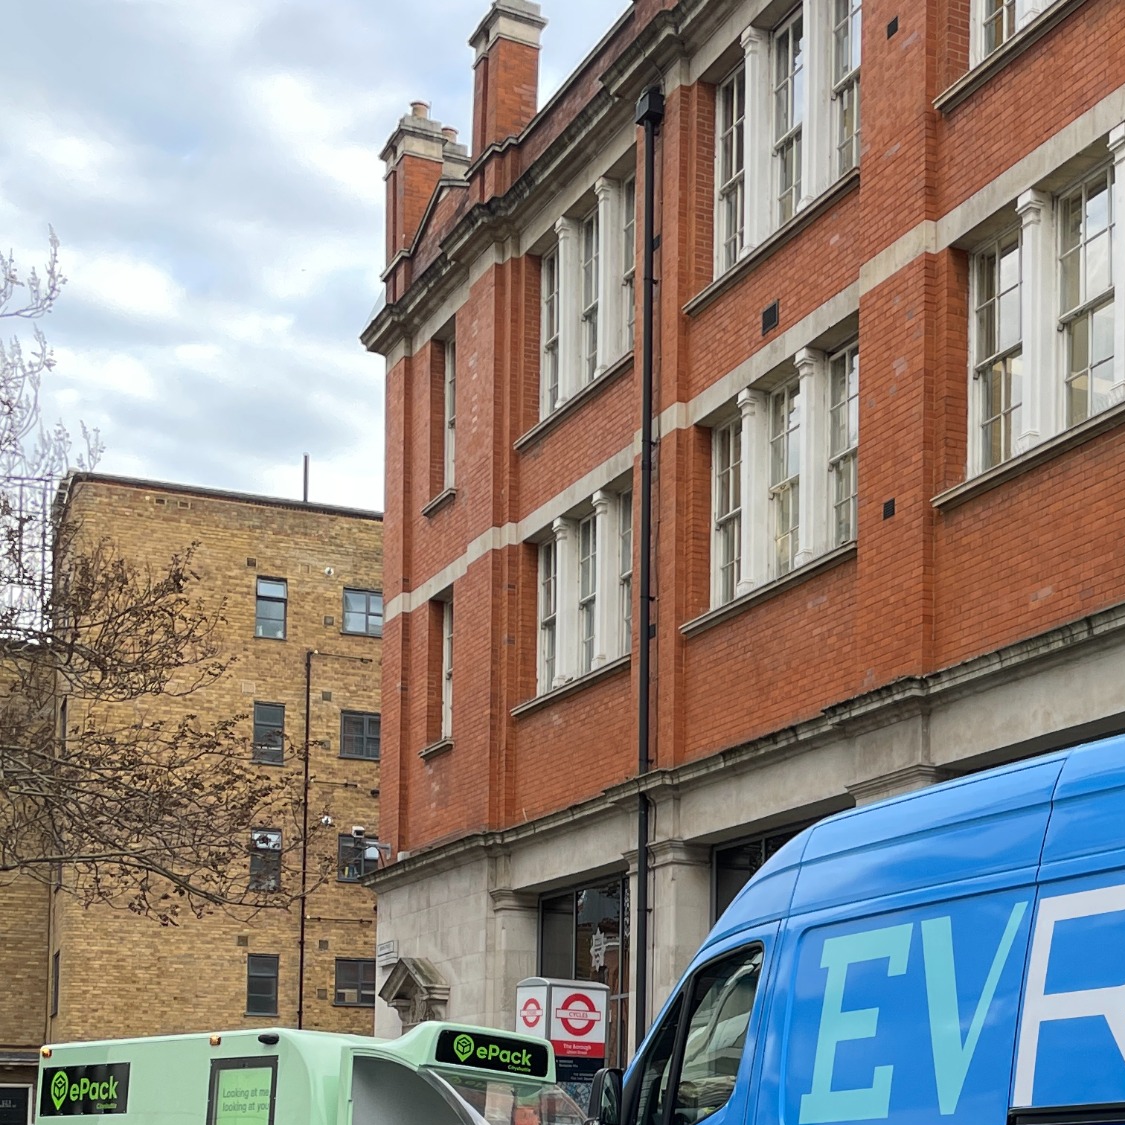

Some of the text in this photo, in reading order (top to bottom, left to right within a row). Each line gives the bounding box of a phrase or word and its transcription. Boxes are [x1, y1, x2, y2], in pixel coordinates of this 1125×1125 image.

[476, 1044, 532, 1066] ePack
[69, 1075, 118, 1101] ePack
[223, 1088, 269, 1099] Looking at me
[222, 1102, 268, 1113] looking at you
